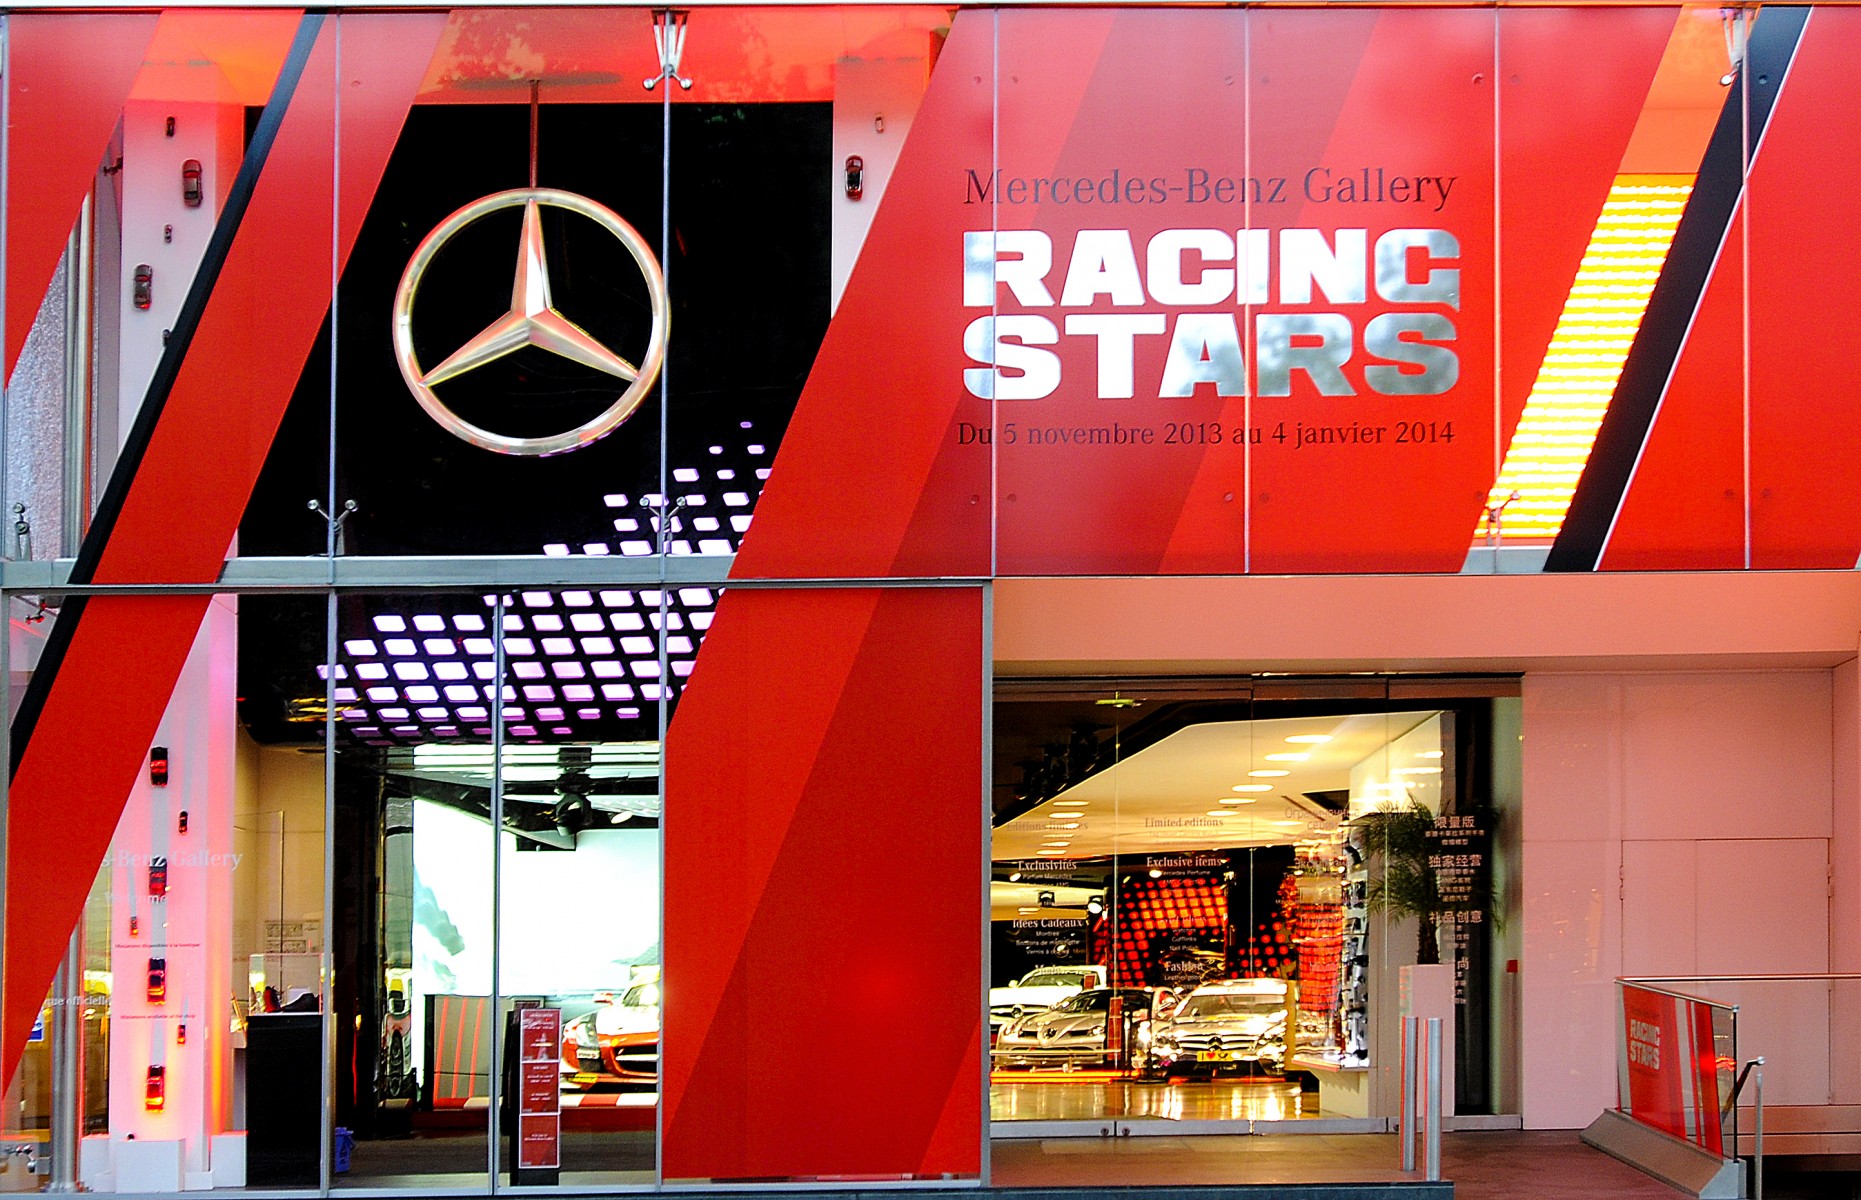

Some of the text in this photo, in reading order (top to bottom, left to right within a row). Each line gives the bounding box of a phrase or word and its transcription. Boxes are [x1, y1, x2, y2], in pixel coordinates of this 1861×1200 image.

[964, 166, 1458, 212] Mercedes-Benz Gallery
[963, 228, 1460, 313] RACING
[963, 312, 1460, 400] STARS
[957, 421, 1455, 450] Du 5 novembre 2013 au 4 janvier 2014
[1145, 817, 1224, 828] Limited editions
[1146, 856, 1222, 868] Exclusive items
[1041, 917, 1083, 929] Cadeaux
